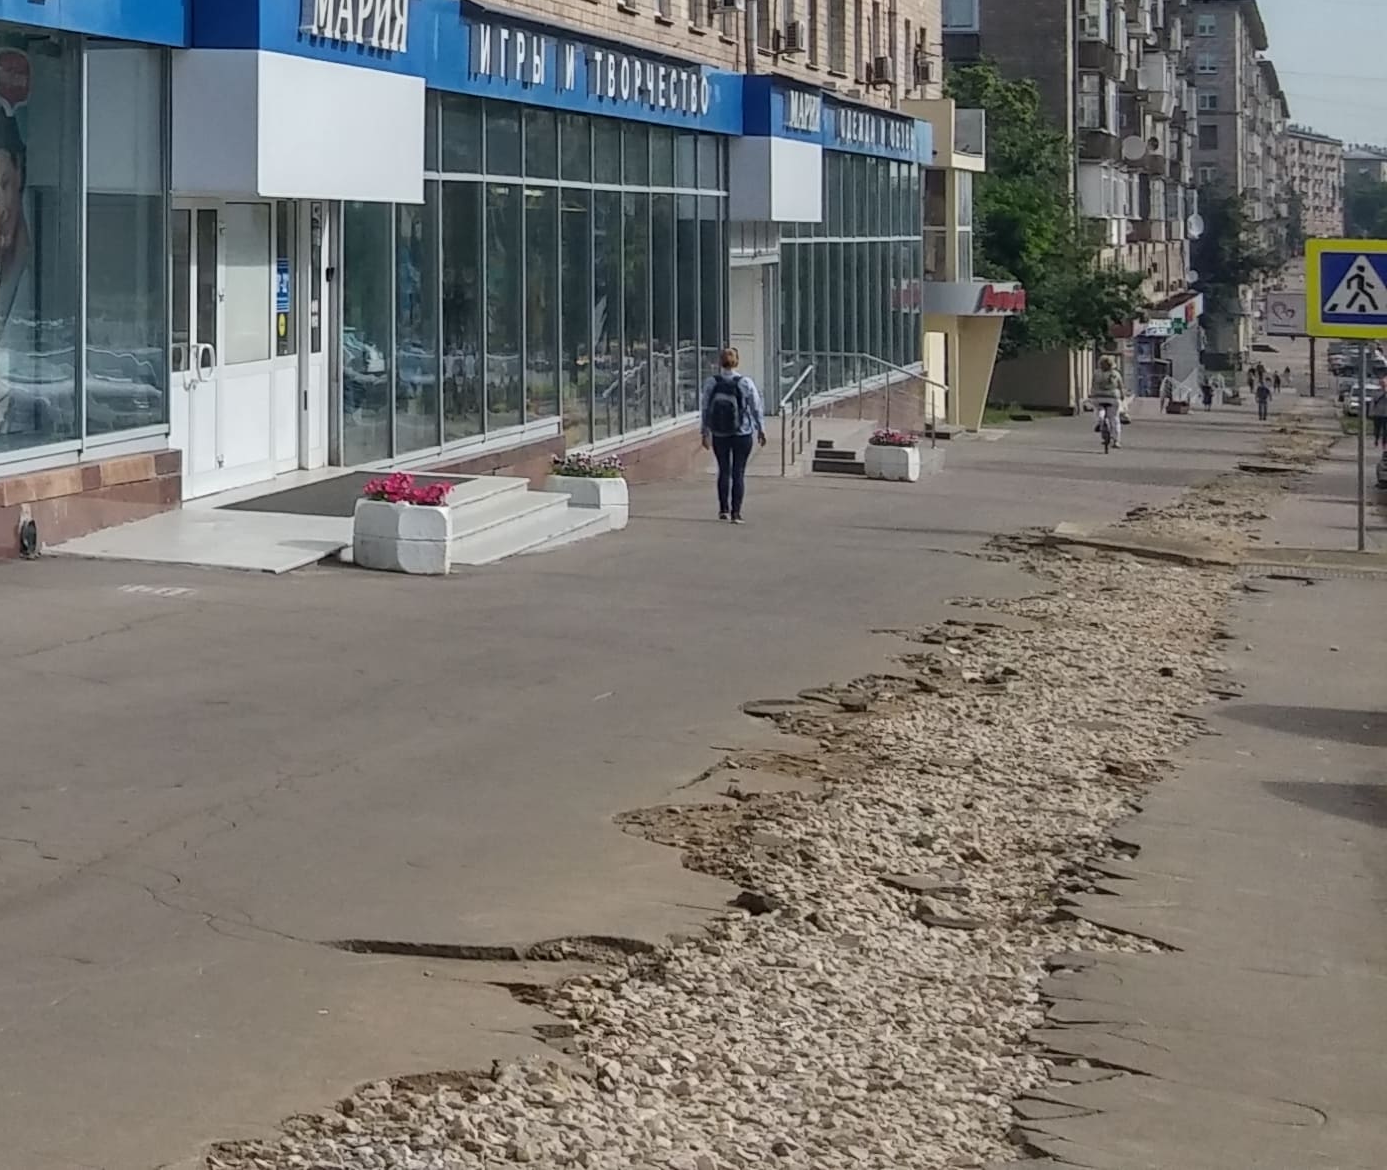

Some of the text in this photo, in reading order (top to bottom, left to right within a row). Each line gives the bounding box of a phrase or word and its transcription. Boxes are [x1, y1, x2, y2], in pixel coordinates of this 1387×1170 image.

[479, 23, 709, 115] ИГРЫ И ТВОРЧЕСТВО
